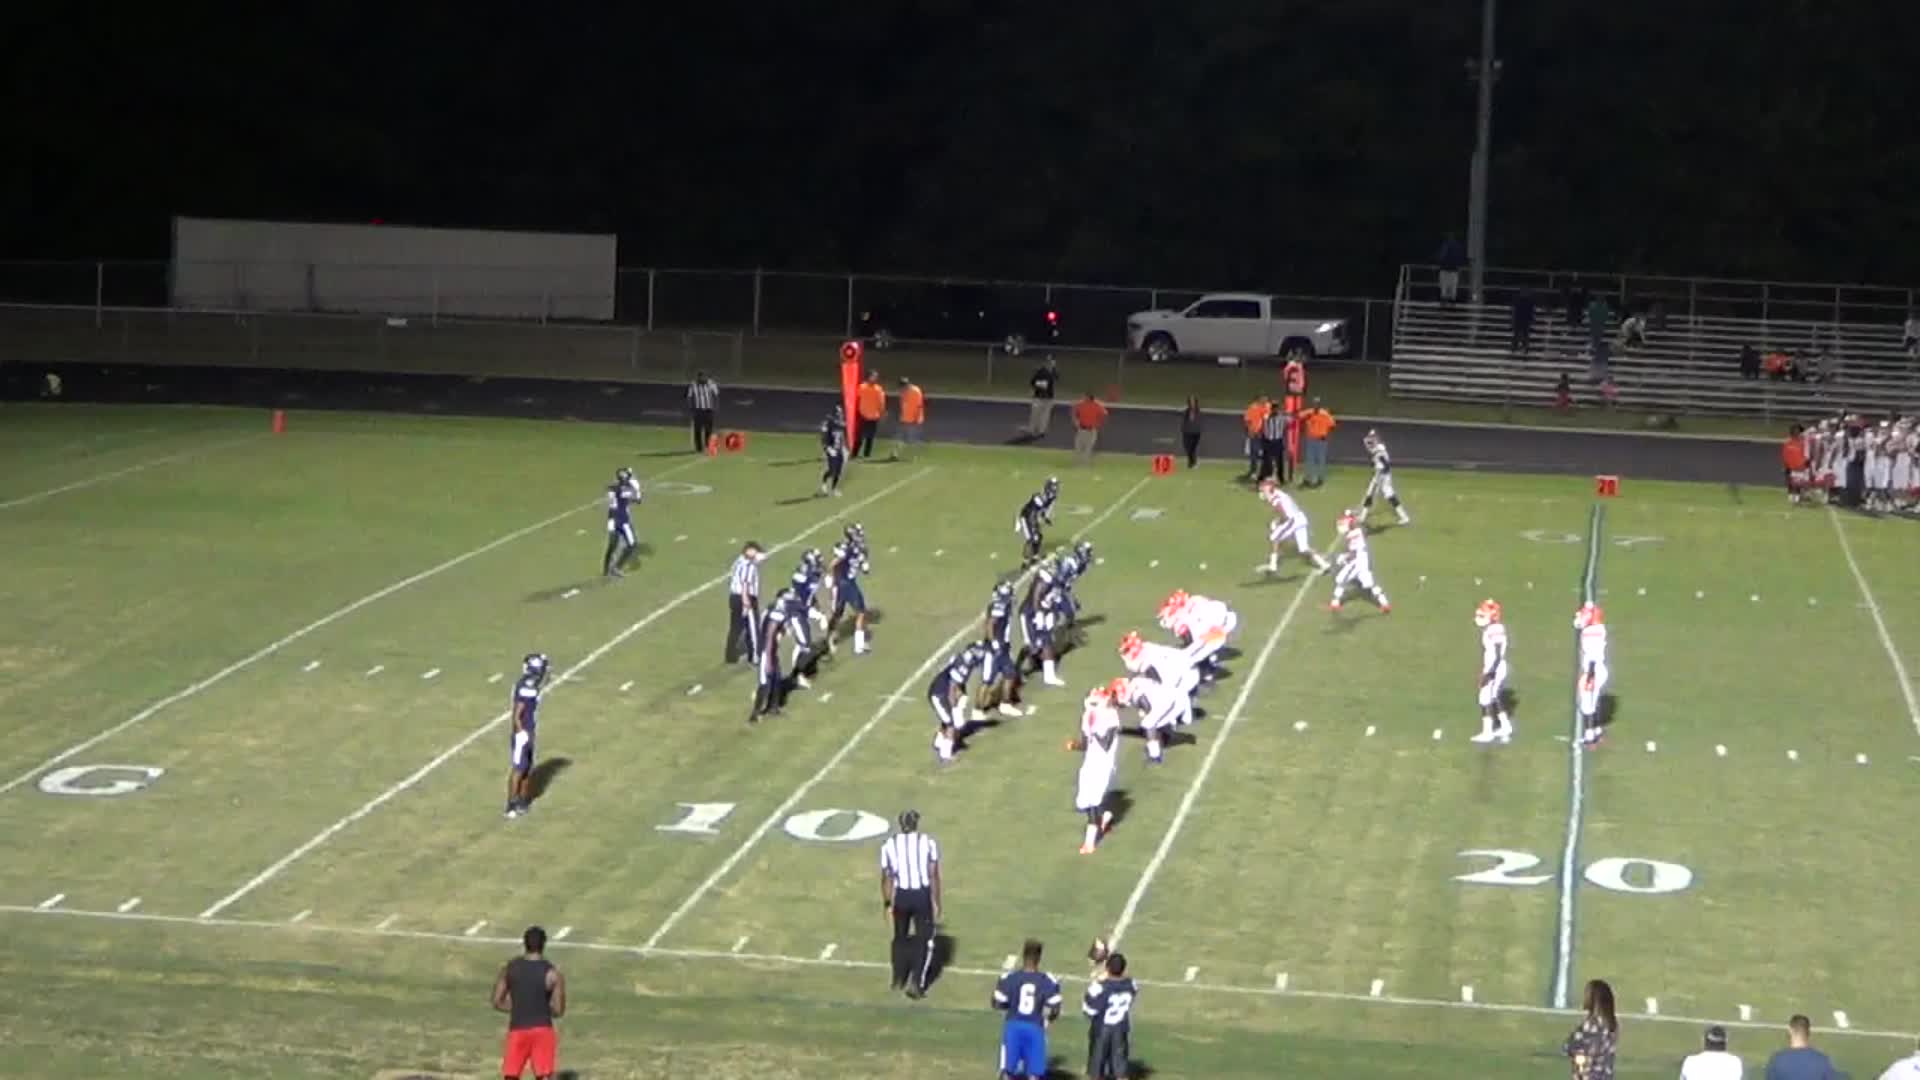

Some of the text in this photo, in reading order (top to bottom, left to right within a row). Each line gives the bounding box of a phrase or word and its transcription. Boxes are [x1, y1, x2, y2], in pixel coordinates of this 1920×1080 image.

[38, 764, 165, 796] G
[654, 802, 890, 841] 10
[1451, 850, 1694, 893] 20
[1018, 983, 1036, 1015] 6
